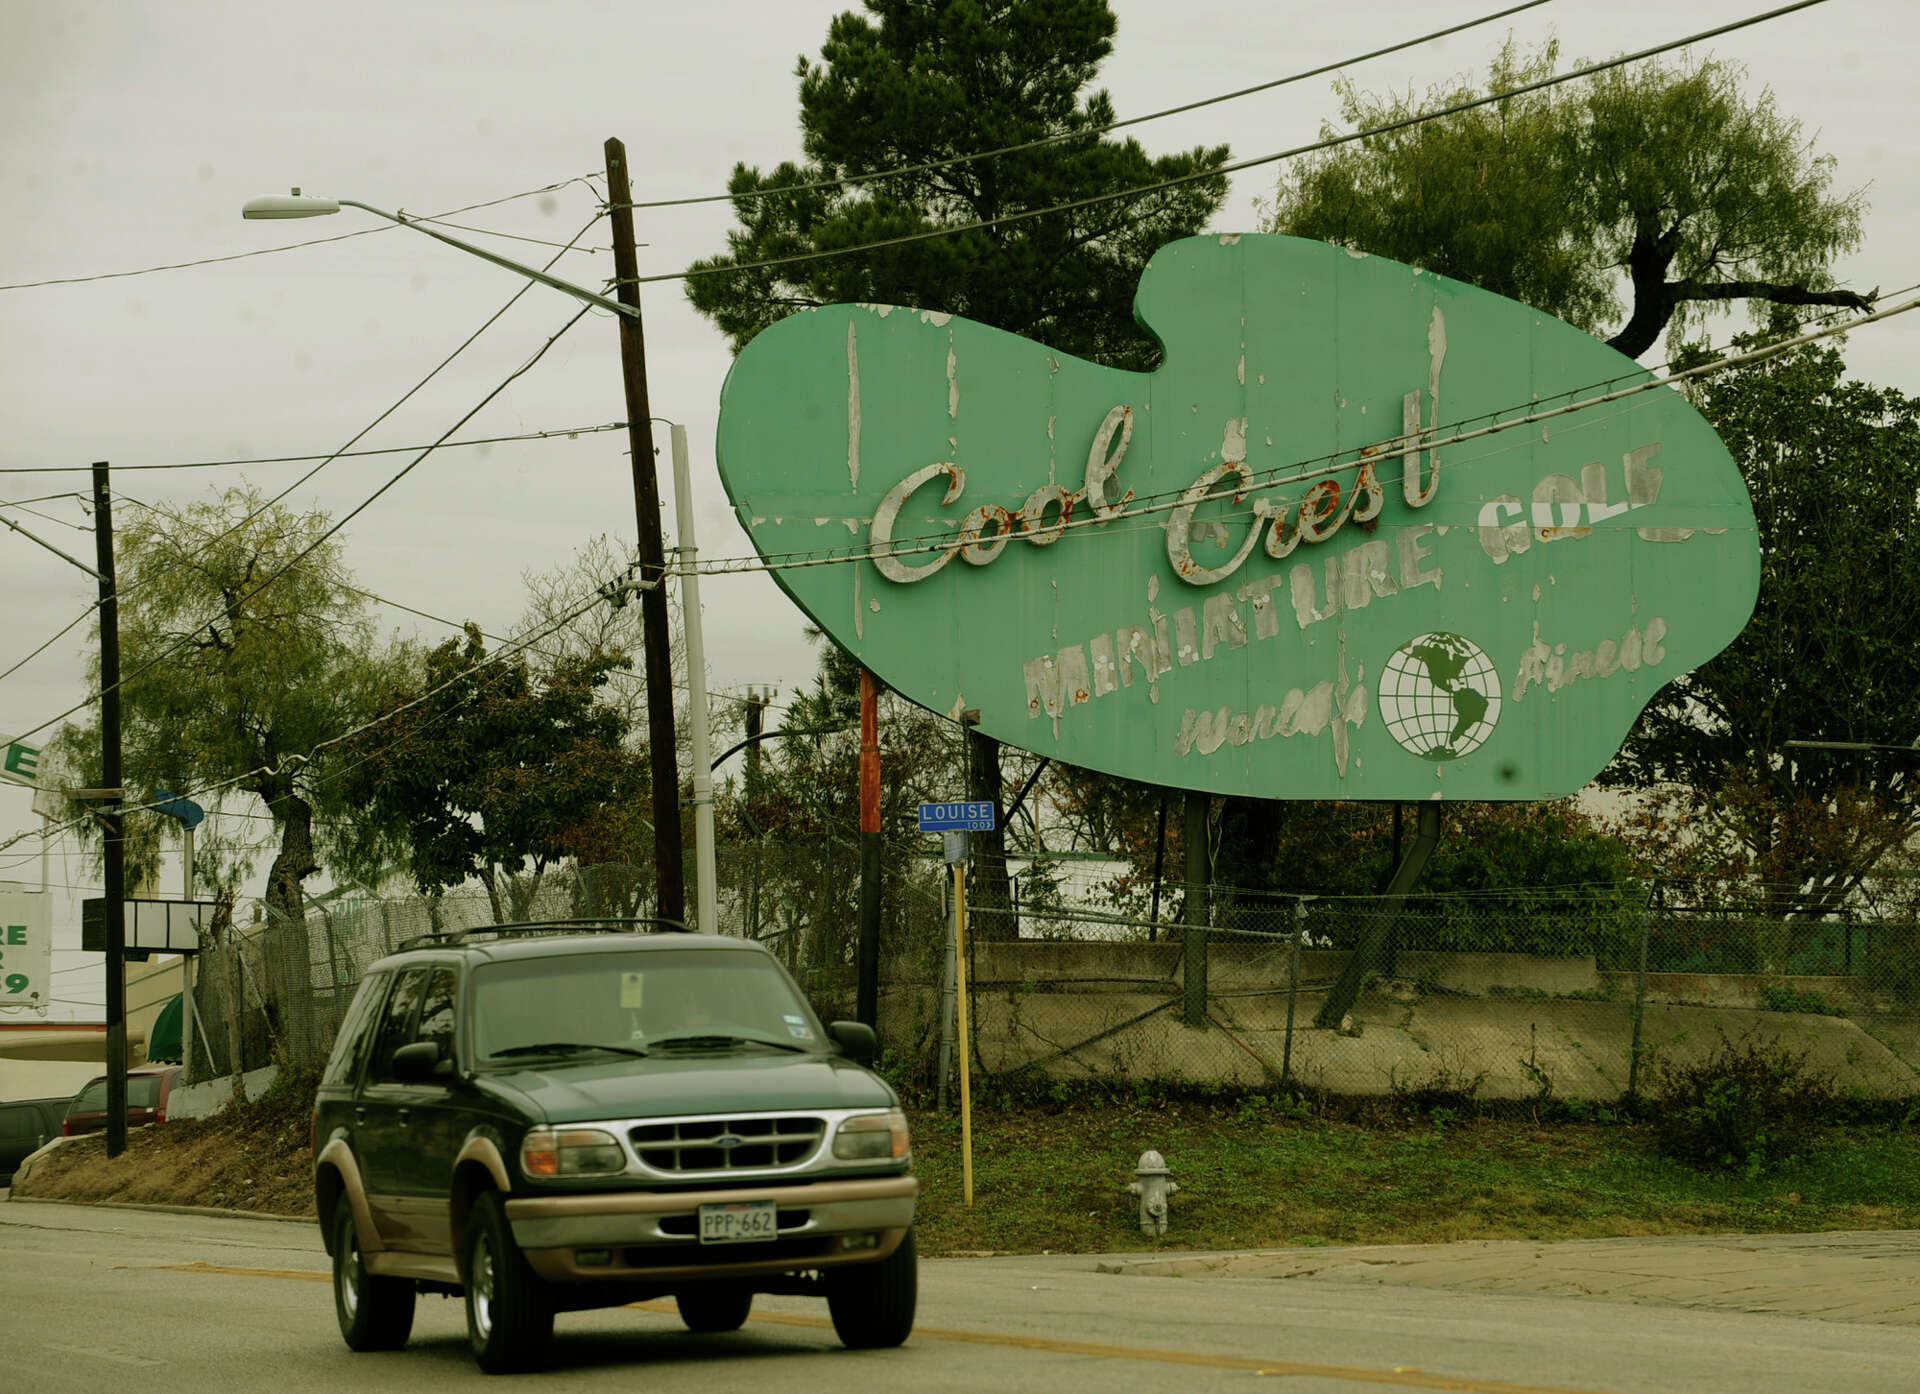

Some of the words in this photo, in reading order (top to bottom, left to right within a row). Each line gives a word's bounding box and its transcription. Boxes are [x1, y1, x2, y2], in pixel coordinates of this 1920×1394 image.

[870, 404, 1134, 584] Cool
[1165, 387, 1438, 586] Crest
[1023, 524, 1443, 719] MINIATURE
[1478, 443, 1663, 562] GOLF
[922, 804, 990, 820] LOUISE
[0, 925, 28, 946] E
[0, 973, 30, 994] 9
